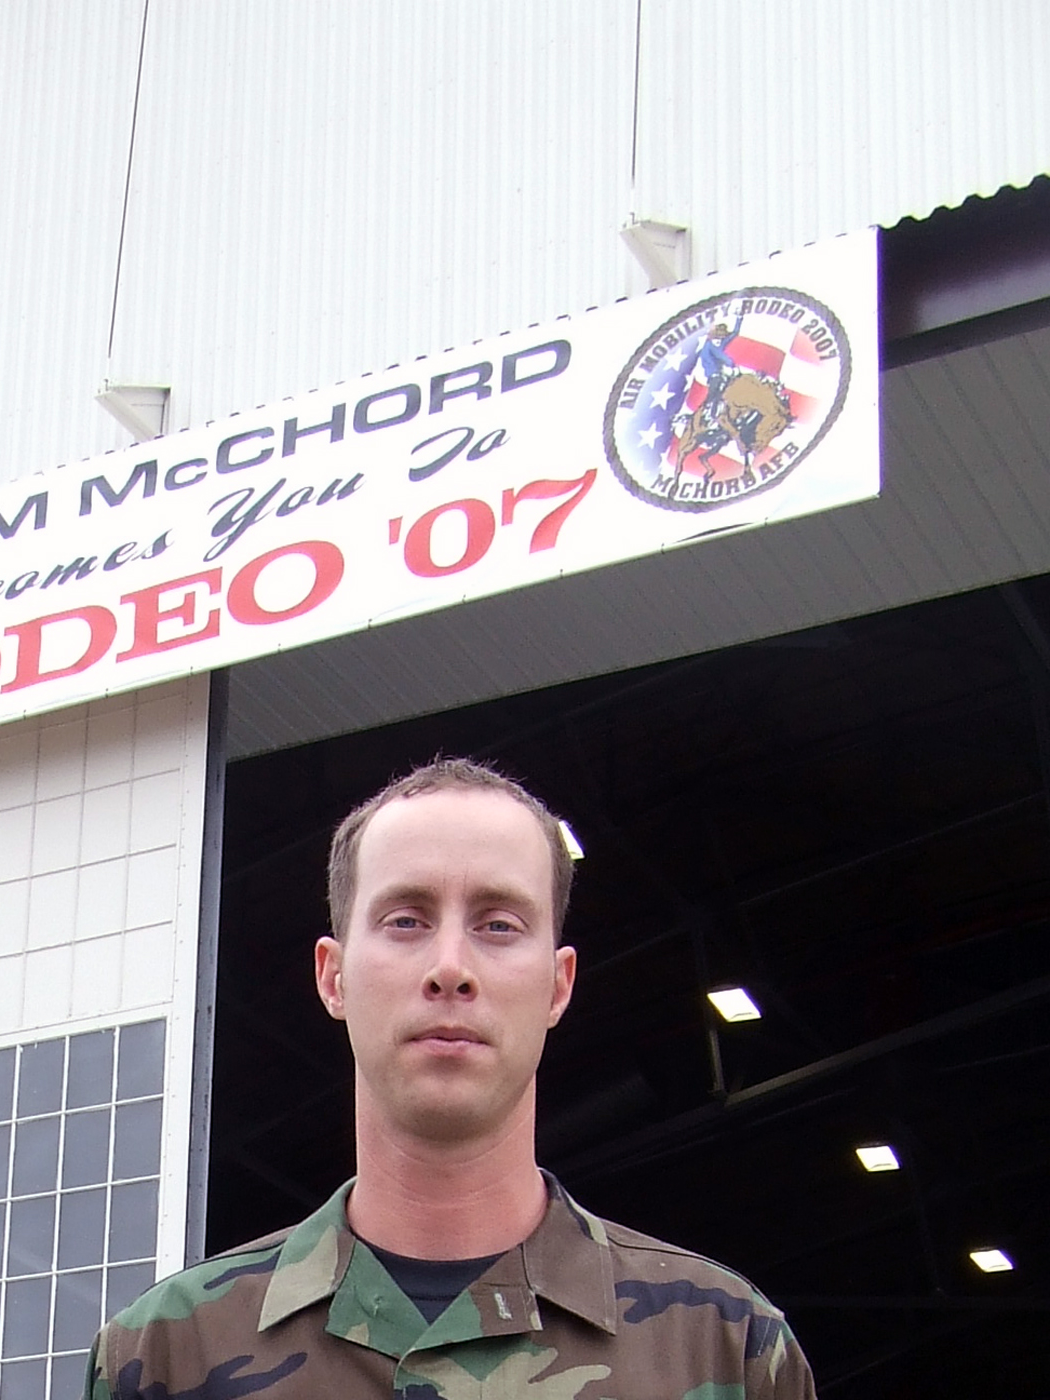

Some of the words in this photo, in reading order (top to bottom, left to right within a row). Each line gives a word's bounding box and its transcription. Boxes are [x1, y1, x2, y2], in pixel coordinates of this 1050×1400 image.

[618, 376, 645, 410] AIR
[639, 301, 732, 373] MOBILITY
[741, 298, 805, 324] RODEO
[801, 318, 839, 362] 2007
[78, 338, 572, 517] McCHORD
[759, 441, 800, 481] AFB
[202, 471, 366, 563] You
[408, 425, 511, 483] To
[388, 468, 598, 579] '07
